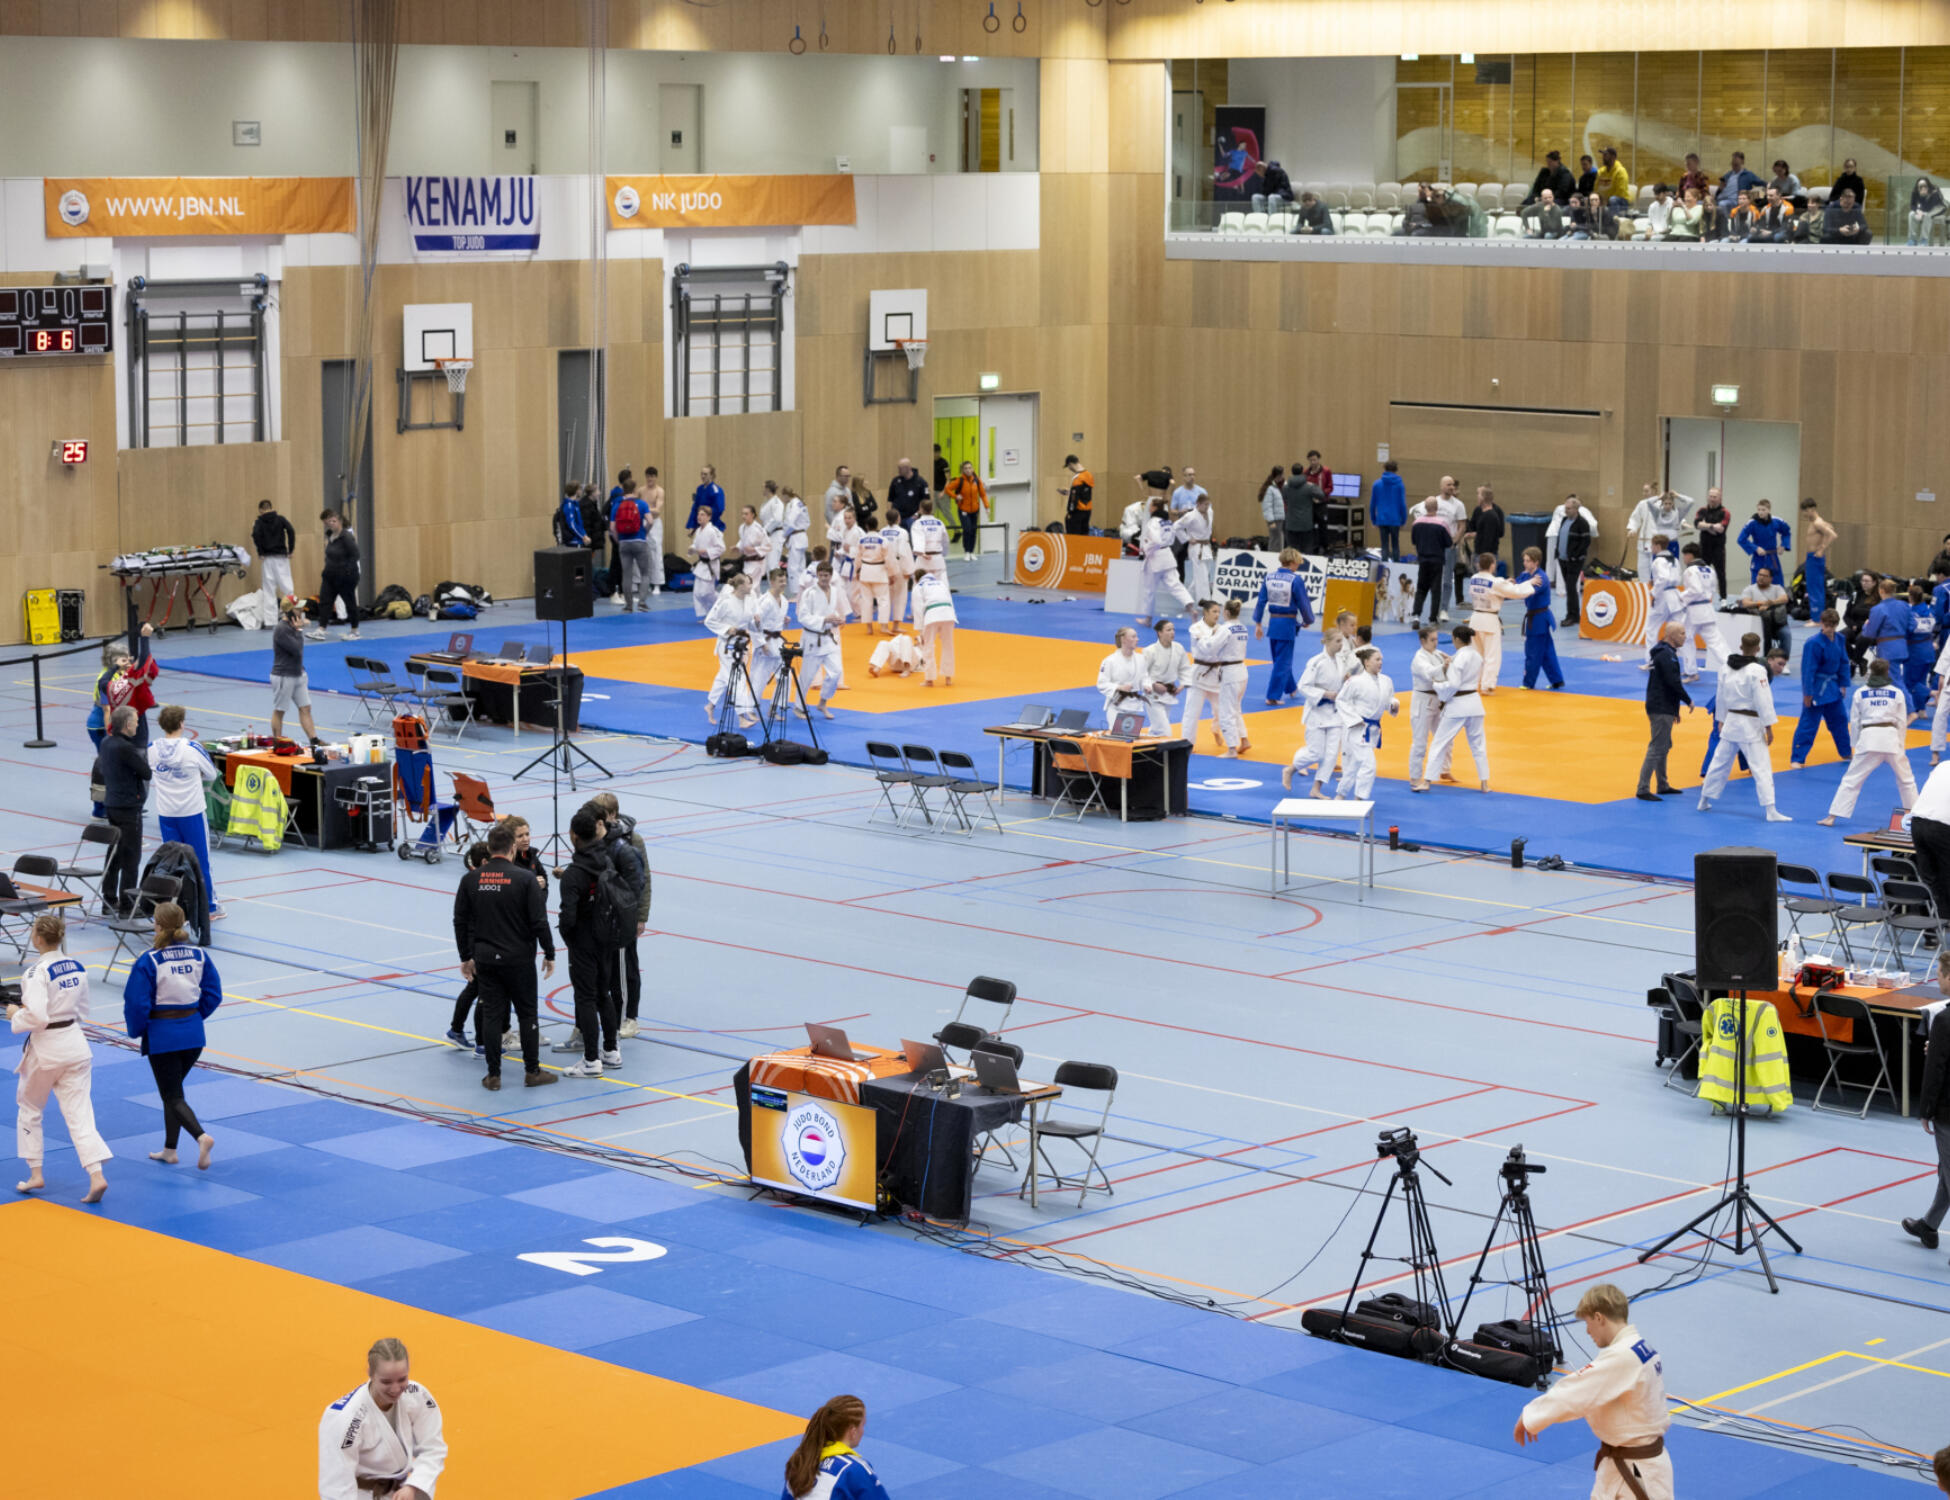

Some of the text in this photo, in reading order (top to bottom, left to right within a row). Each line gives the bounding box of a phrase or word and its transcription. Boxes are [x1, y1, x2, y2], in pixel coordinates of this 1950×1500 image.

[105, 196, 246, 221] WWW.JBN.NL
[406, 176, 534, 226] KENAMJU
[651, 193, 677, 210] NK
[679, 192, 722, 214] JUDO
[63, 442, 86, 462] 25
[1083, 553, 1103, 566] JBN
[1328, 558, 1370, 570] JEUGD
[1217, 567, 1268, 580] BOUW
[1327, 566, 1369, 578] FONDS
[170, 964, 193, 975] NED
[59, 977, 80, 990] NED
[793, 1112, 835, 1138] JUDO BOND
[791, 1151, 836, 1182] NEDERLAND
[515, 1236, 668, 1277] 2
